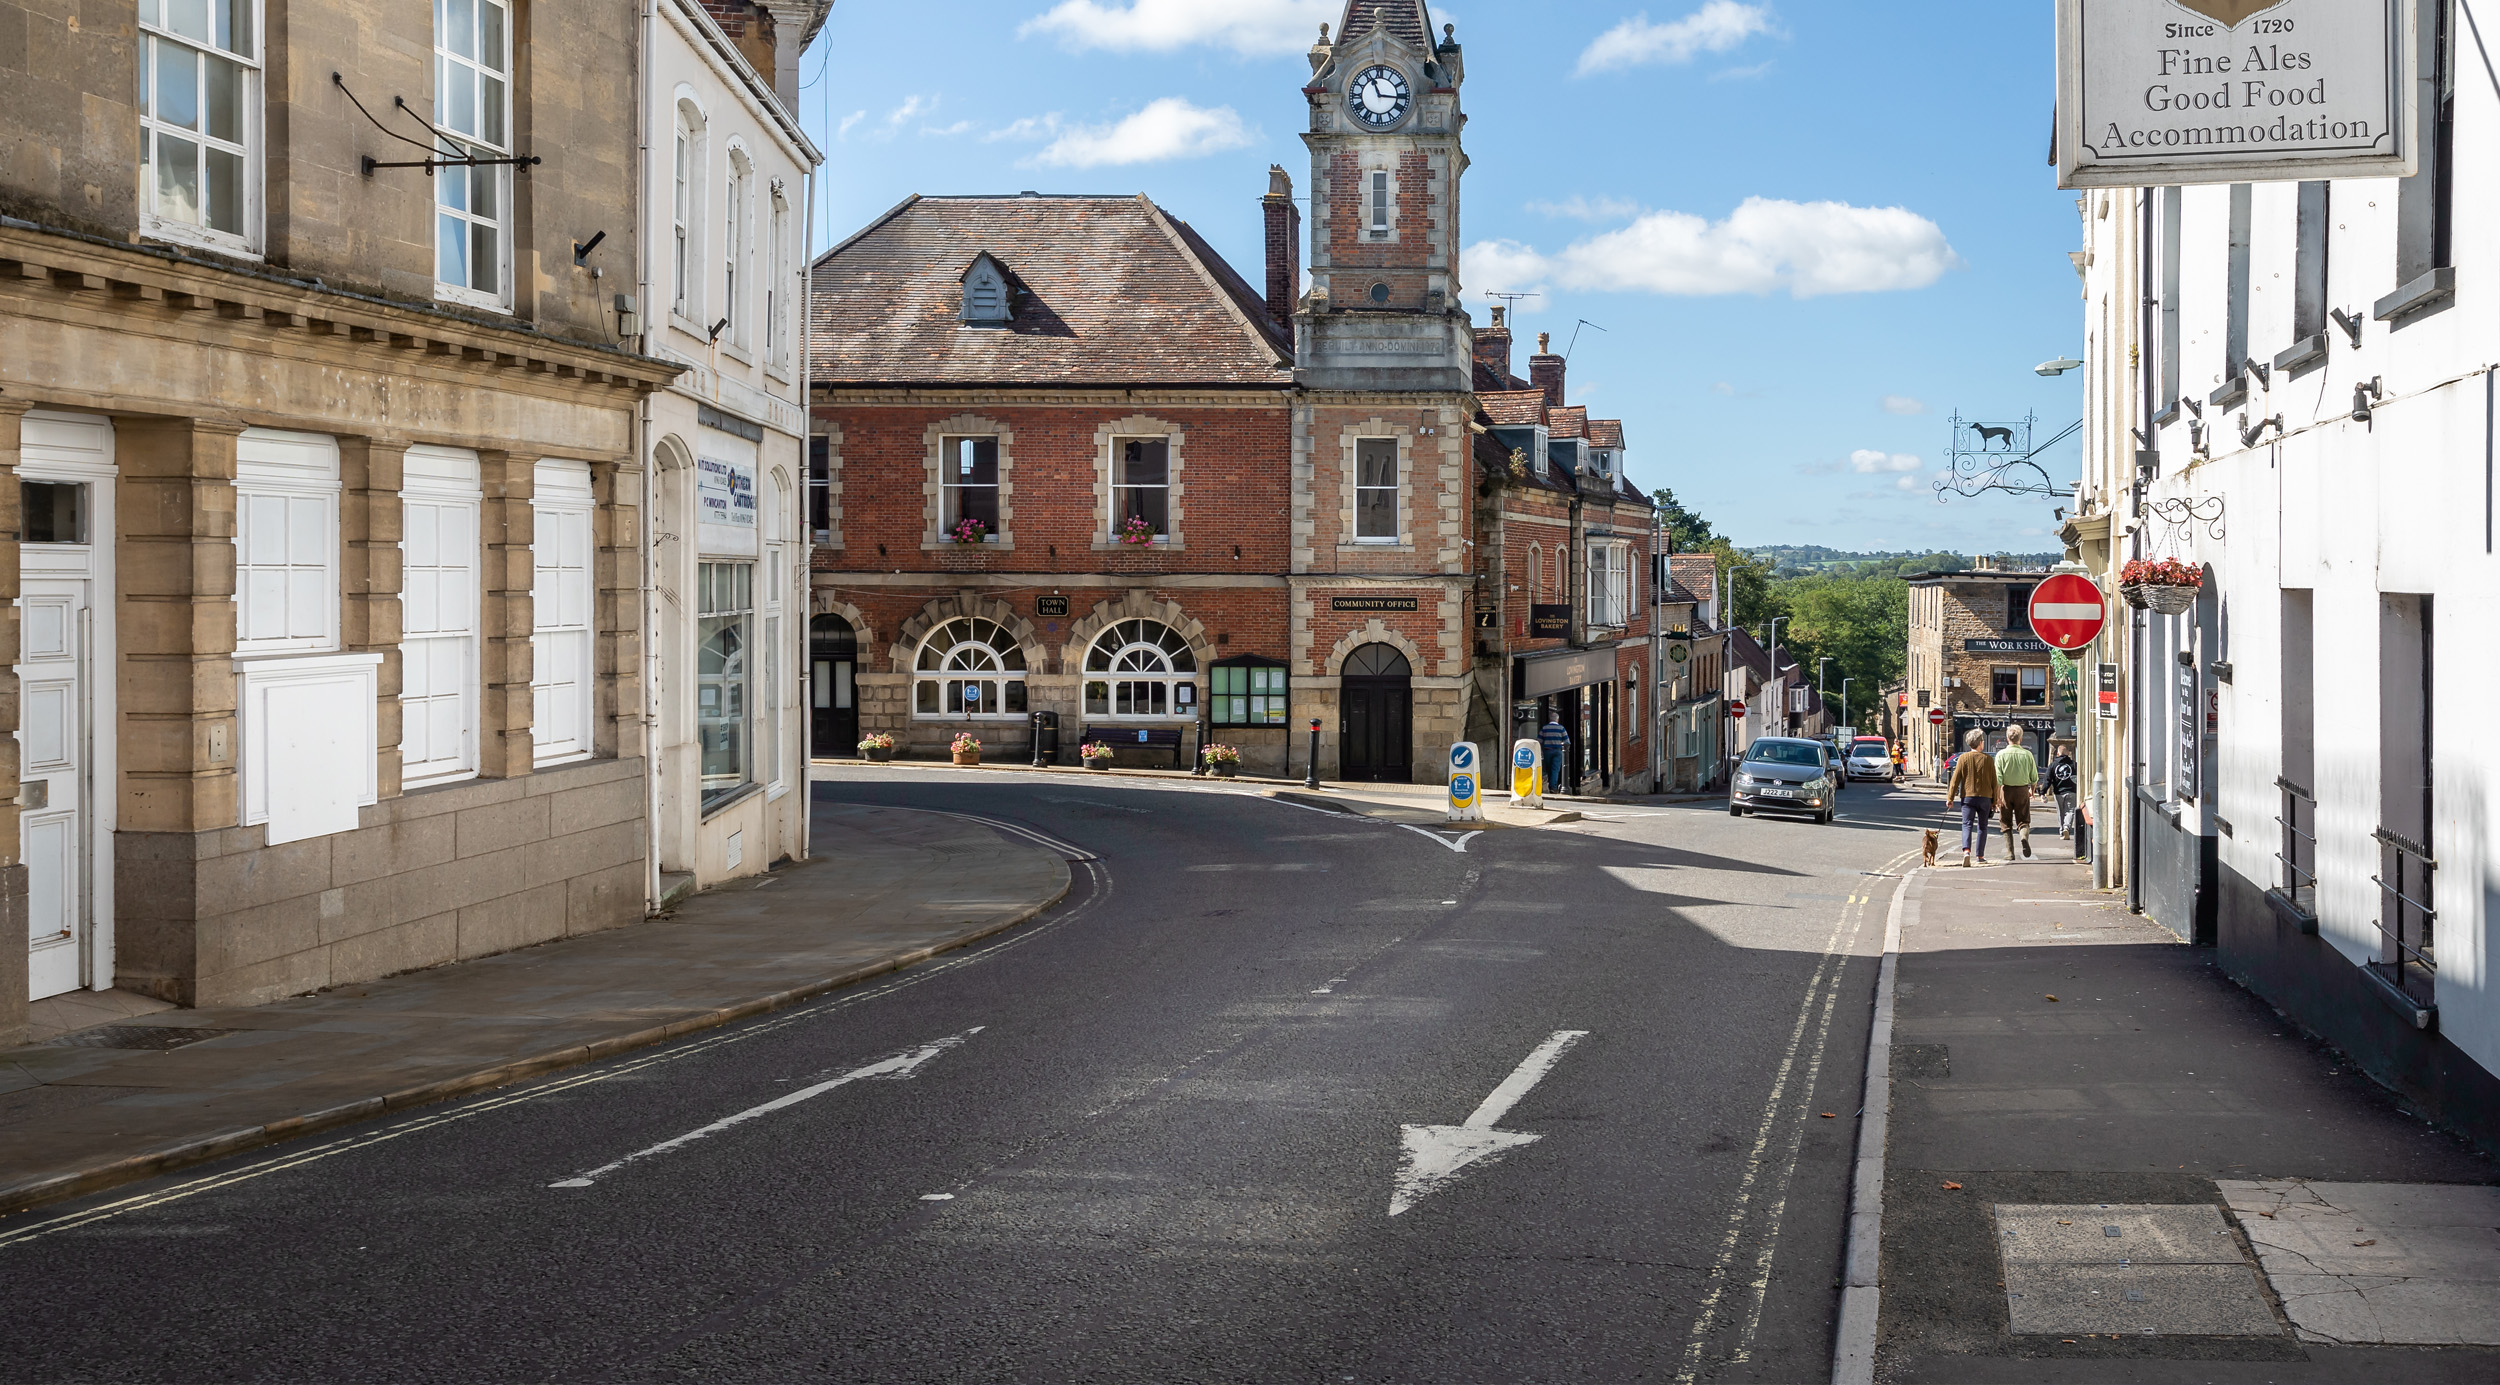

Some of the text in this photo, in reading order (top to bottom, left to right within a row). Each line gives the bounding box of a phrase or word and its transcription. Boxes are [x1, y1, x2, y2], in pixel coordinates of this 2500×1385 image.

[2165, 18, 2295, 39] Since 1720
[2157, 44, 2312, 76] Fine Ales
[2143, 78, 2326, 112] Good Food
[2101, 114, 2371, 149] Accommodation
